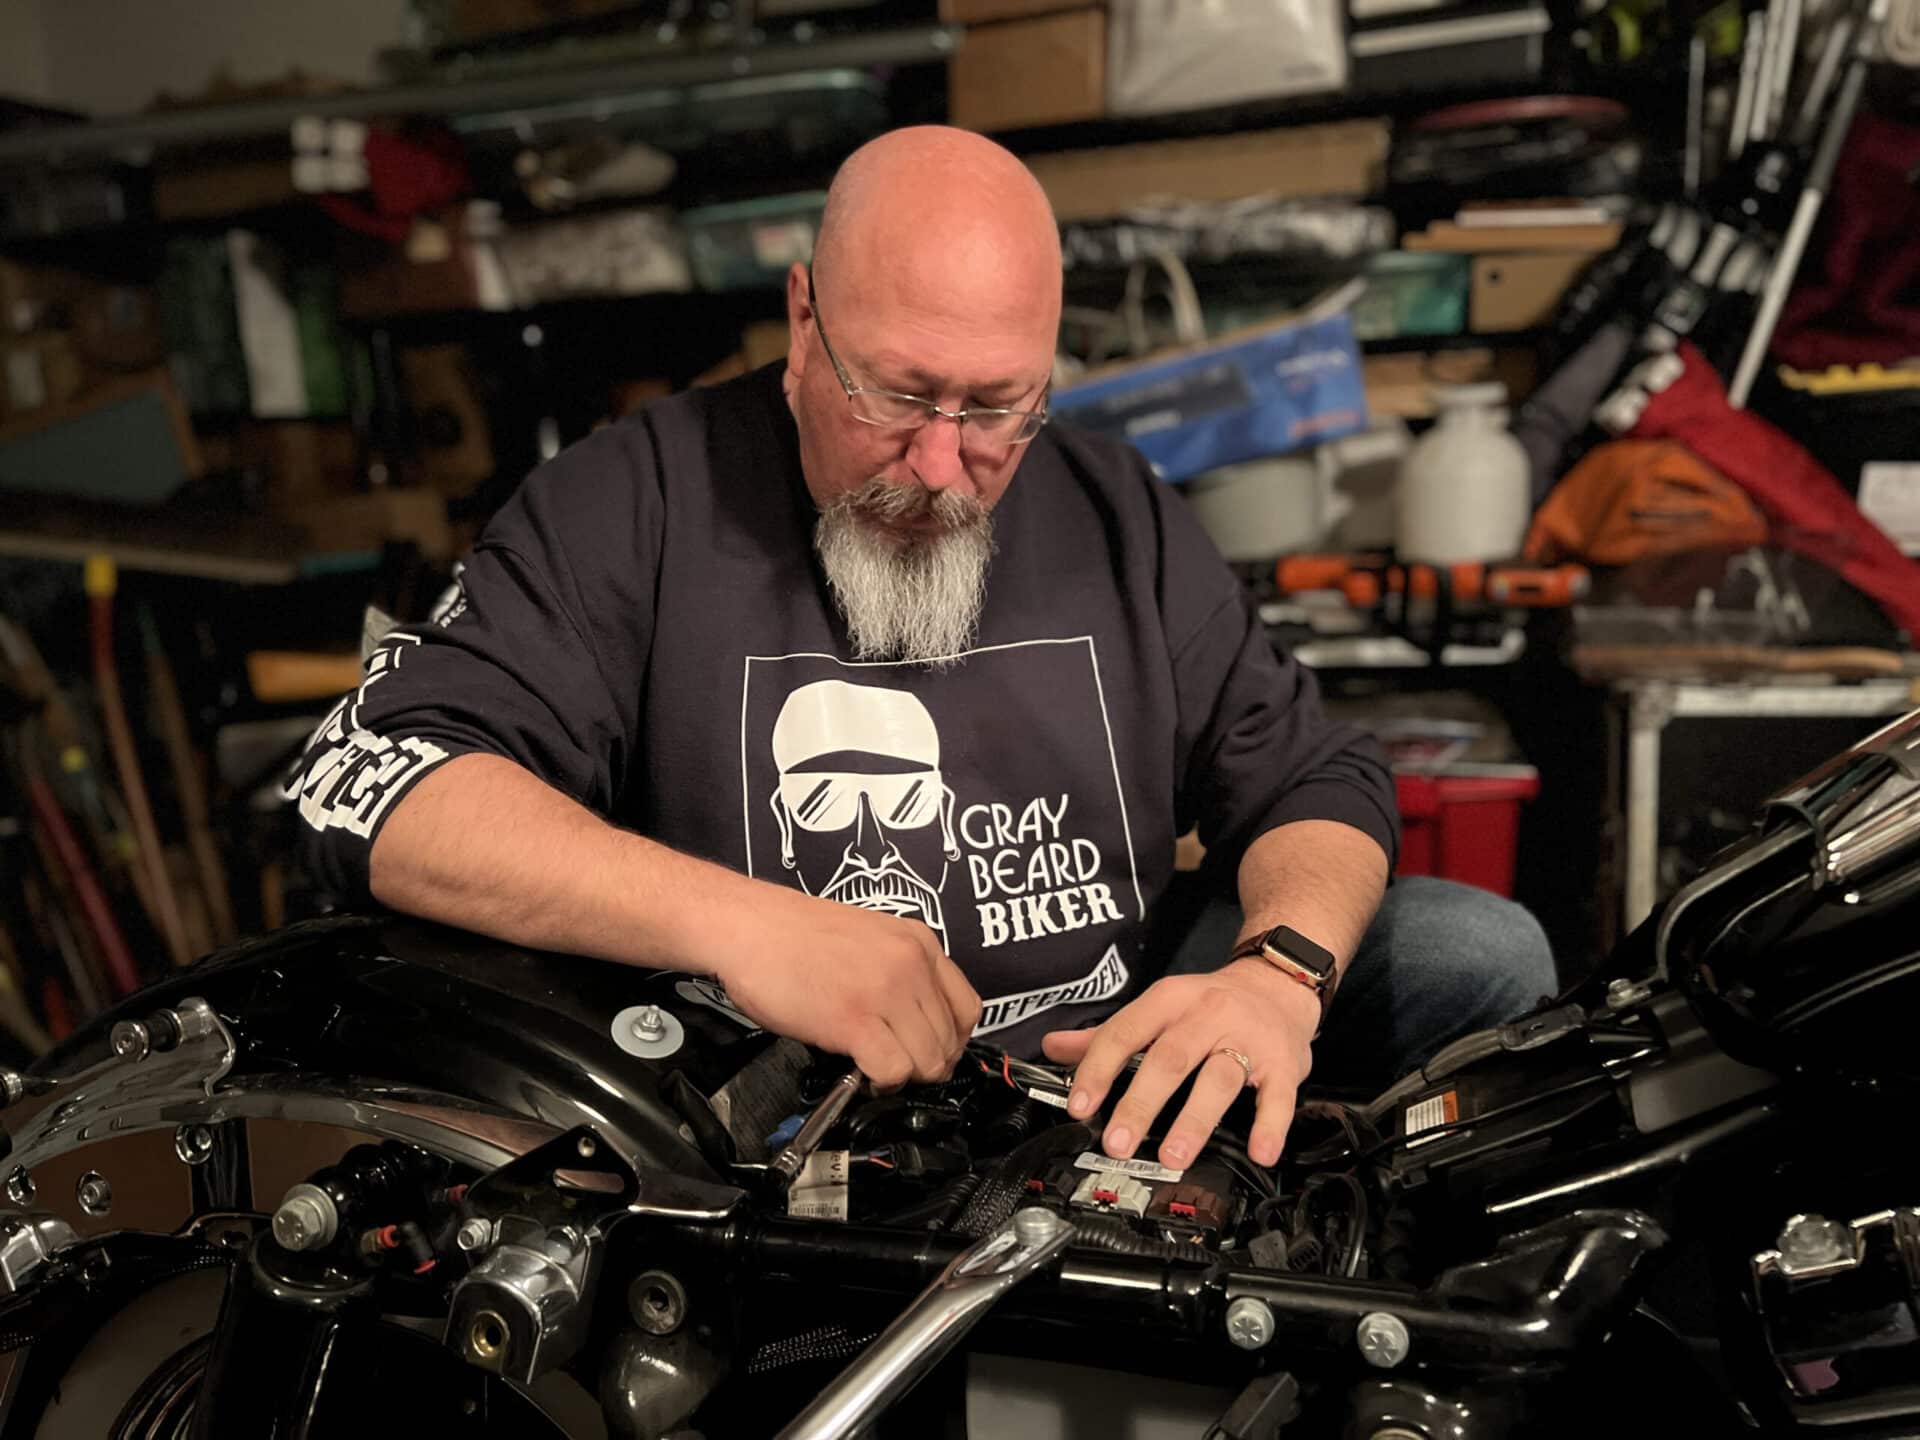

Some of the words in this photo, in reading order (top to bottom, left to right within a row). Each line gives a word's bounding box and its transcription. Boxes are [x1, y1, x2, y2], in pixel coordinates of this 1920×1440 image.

[960, 793, 1069, 849] GRAY
[968, 838, 1100, 899] BEARD
[976, 883, 1124, 947] BIKER
[977, 953, 1123, 1029] OFFENDER
